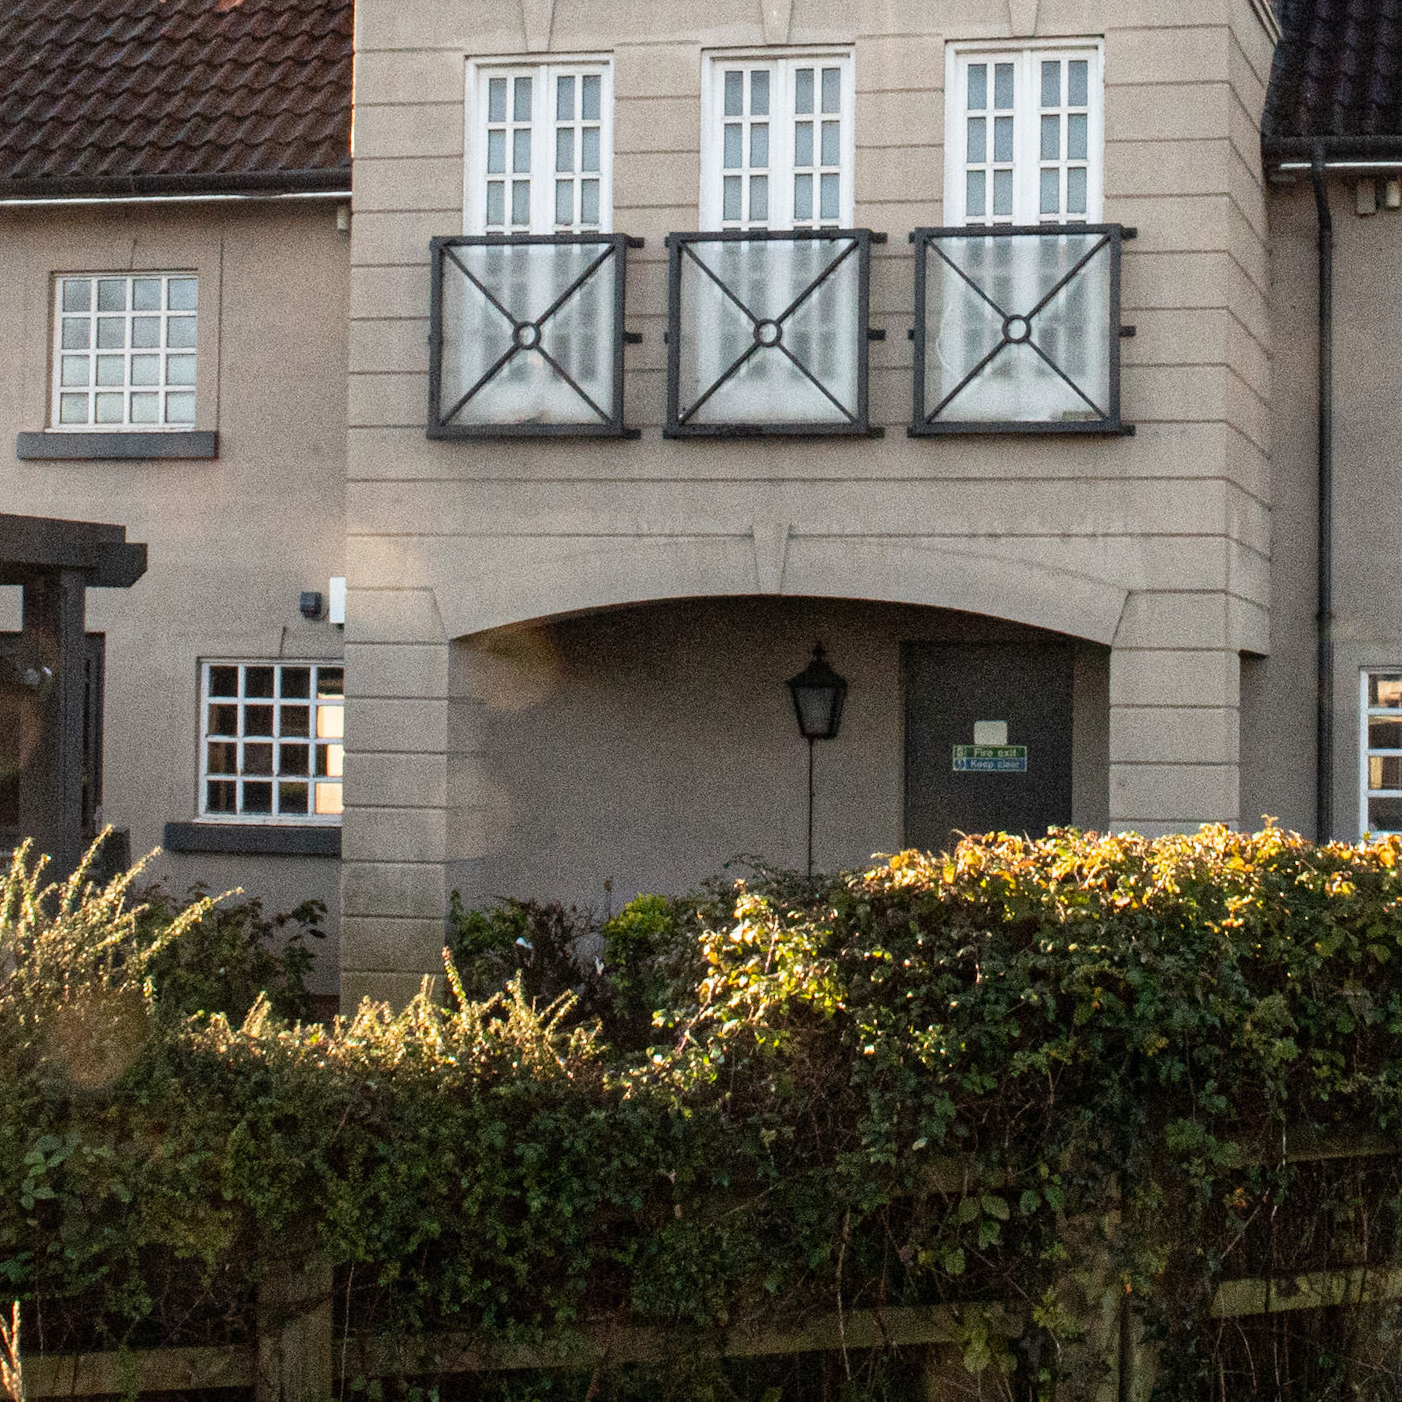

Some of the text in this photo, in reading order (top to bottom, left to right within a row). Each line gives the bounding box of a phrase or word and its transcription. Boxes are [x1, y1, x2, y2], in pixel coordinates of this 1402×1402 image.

[974, 748, 1016, 757] Fire exit
[970, 759, 994, 769] Keep
